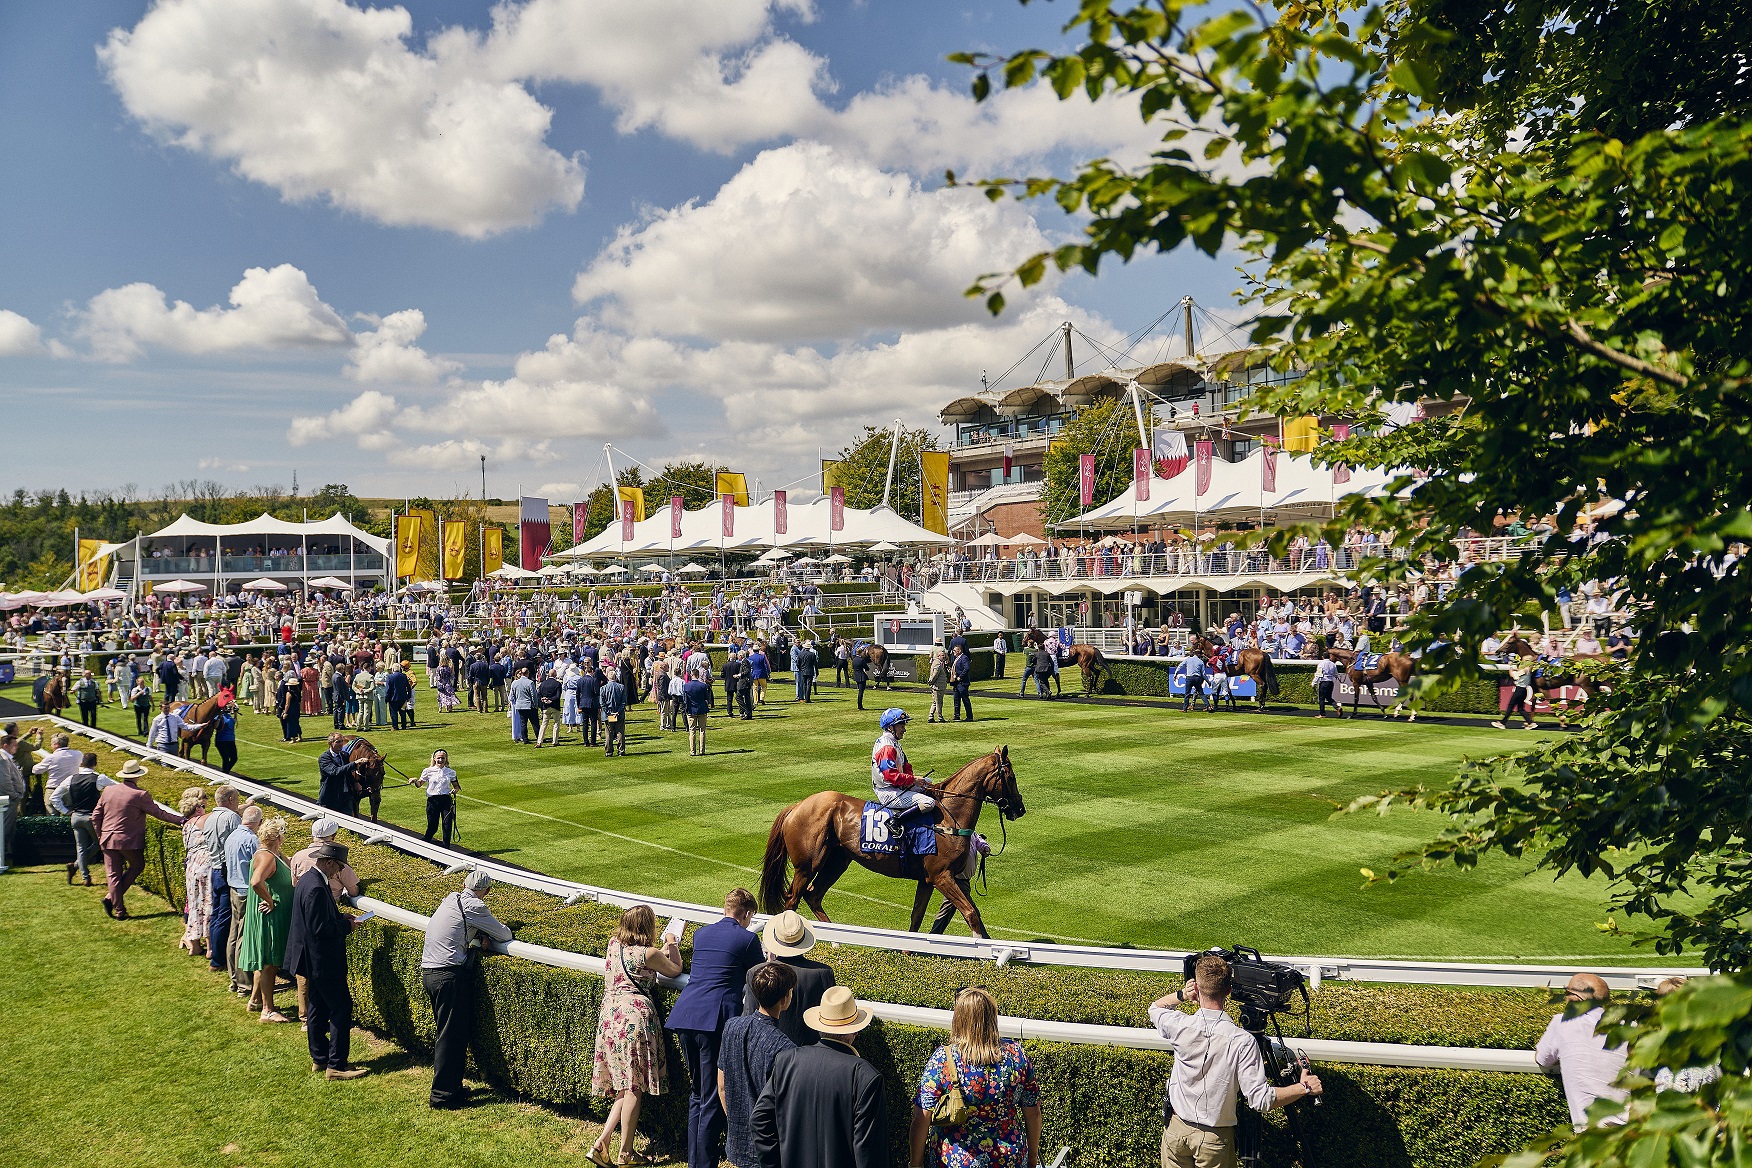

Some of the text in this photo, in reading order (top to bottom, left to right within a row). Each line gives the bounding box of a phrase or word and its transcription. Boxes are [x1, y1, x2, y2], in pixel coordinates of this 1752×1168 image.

[1261, 596, 1268, 607] 2
[1081, 603, 1086, 613] 1
[1176, 613, 1183, 626] 3
[892, 620, 898, 632] 4
[1173, 673, 1239, 690] CRL
[1340, 683, 1399, 697] Bonhams
[863, 808, 890, 843] 13
[861, 842, 895, 852] CORAL
